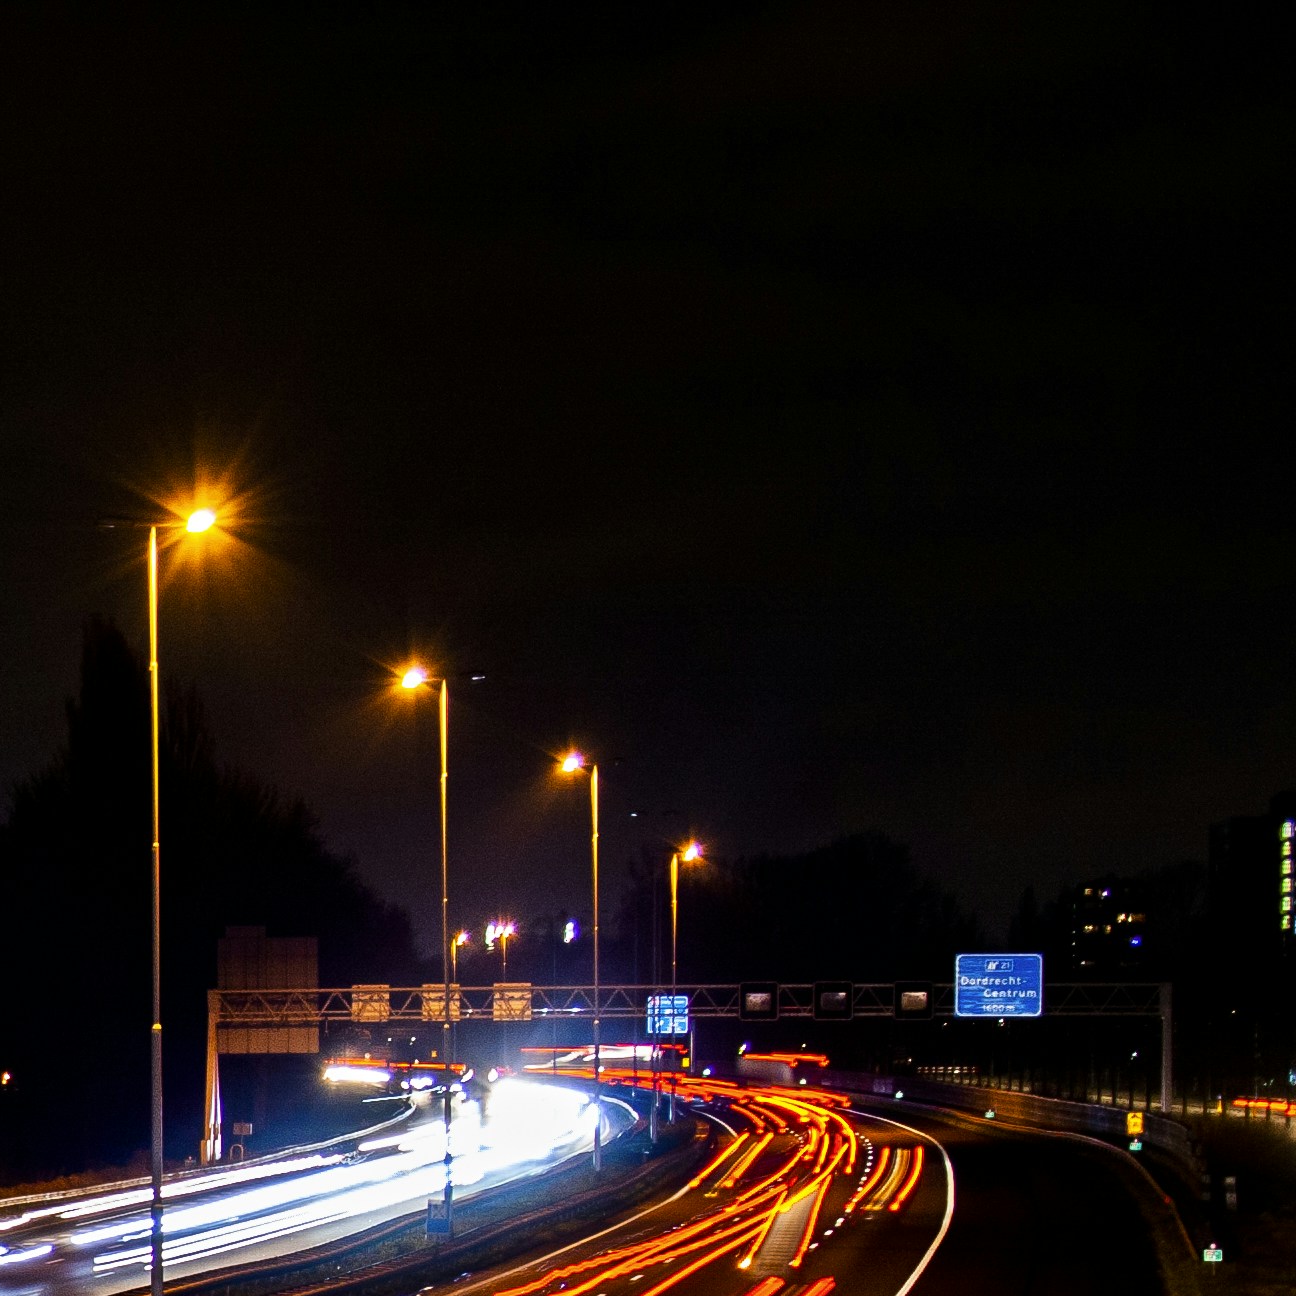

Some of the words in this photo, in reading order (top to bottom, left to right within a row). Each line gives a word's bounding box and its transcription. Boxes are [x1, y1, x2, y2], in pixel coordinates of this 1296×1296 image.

[1001, 962, 1010, 970] 21
[961, 976, 1027, 986] Dordrecht-
[983, 988, 1037, 998] Centrum
